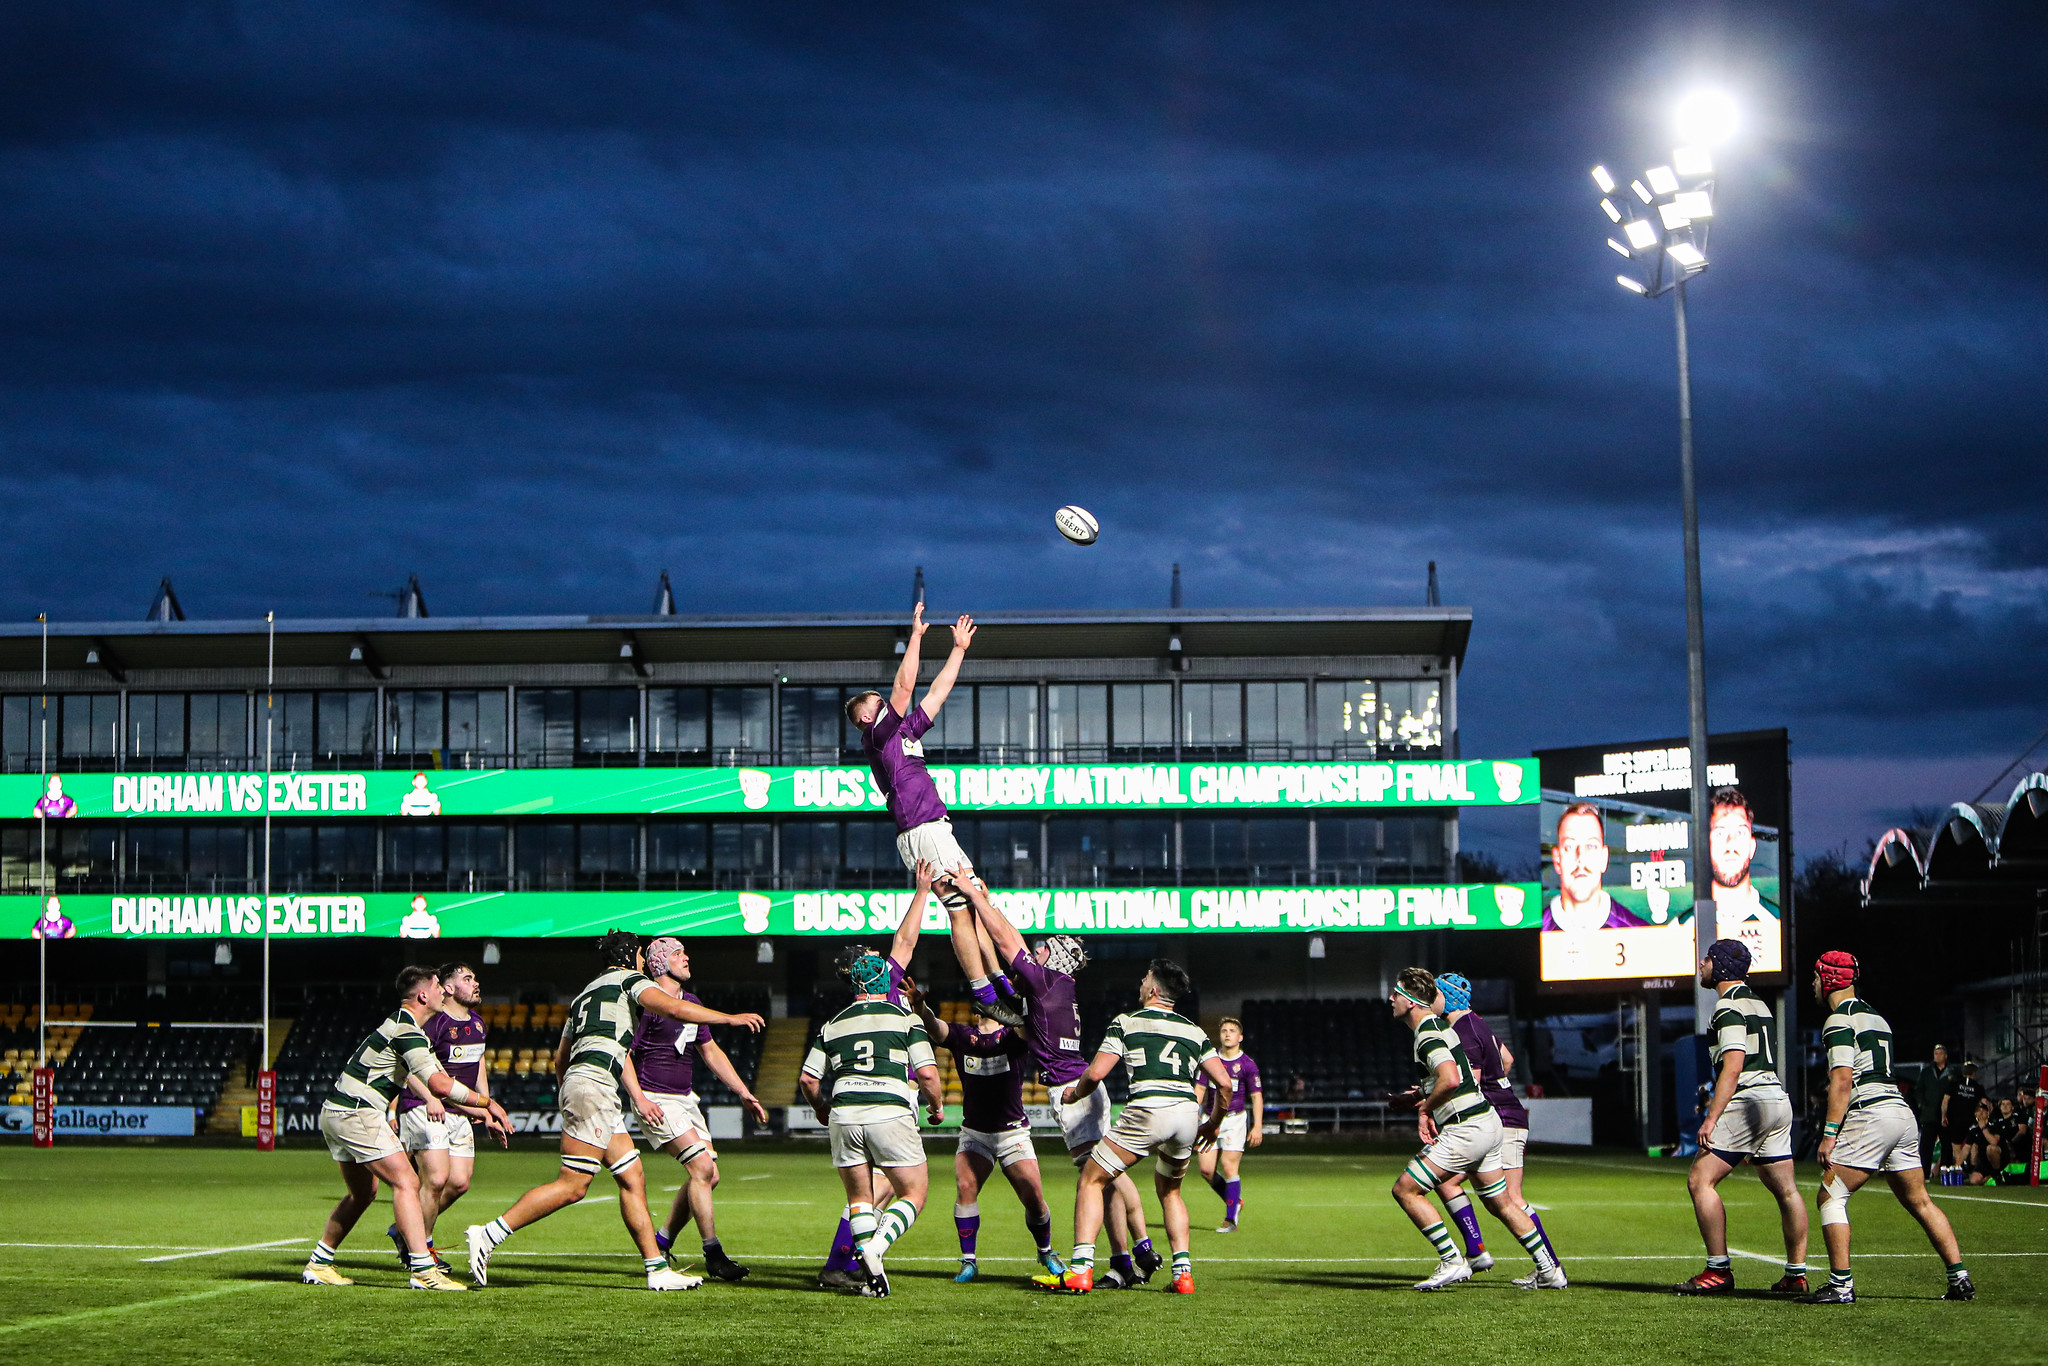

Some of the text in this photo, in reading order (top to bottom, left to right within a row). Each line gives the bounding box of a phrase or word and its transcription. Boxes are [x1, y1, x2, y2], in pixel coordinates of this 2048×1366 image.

[113, 774, 367, 812] DURHAM VS EXETER
[794, 769, 865, 807] BUCS
[960, 767, 1051, 805] RUGBY
[1054, 766, 1188, 804] NATIONAL
[1190, 765, 1393, 804] CHAMPIONSHIP
[1397, 764, 1475, 801] FINAL
[111, 896, 366, 934] DURHAM VS EXETER
[794, 893, 865, 931] BUCS
[1054, 891, 1188, 929] NATIONAL
[1191, 889, 1394, 928] CHAMPIONSHIP
[1398, 887, 1477, 925] FINAL
[1615, 943, 1627, 966] 3
[576, 996, 592, 1034] 5
[1071, 1002, 1081, 1037] 5
[853, 1040, 875, 1072] 3
[1158, 1041, 1182, 1076] 4
[261, 1078, 271, 1125] BUCS
[53, 1109, 149, 1133] allagher
